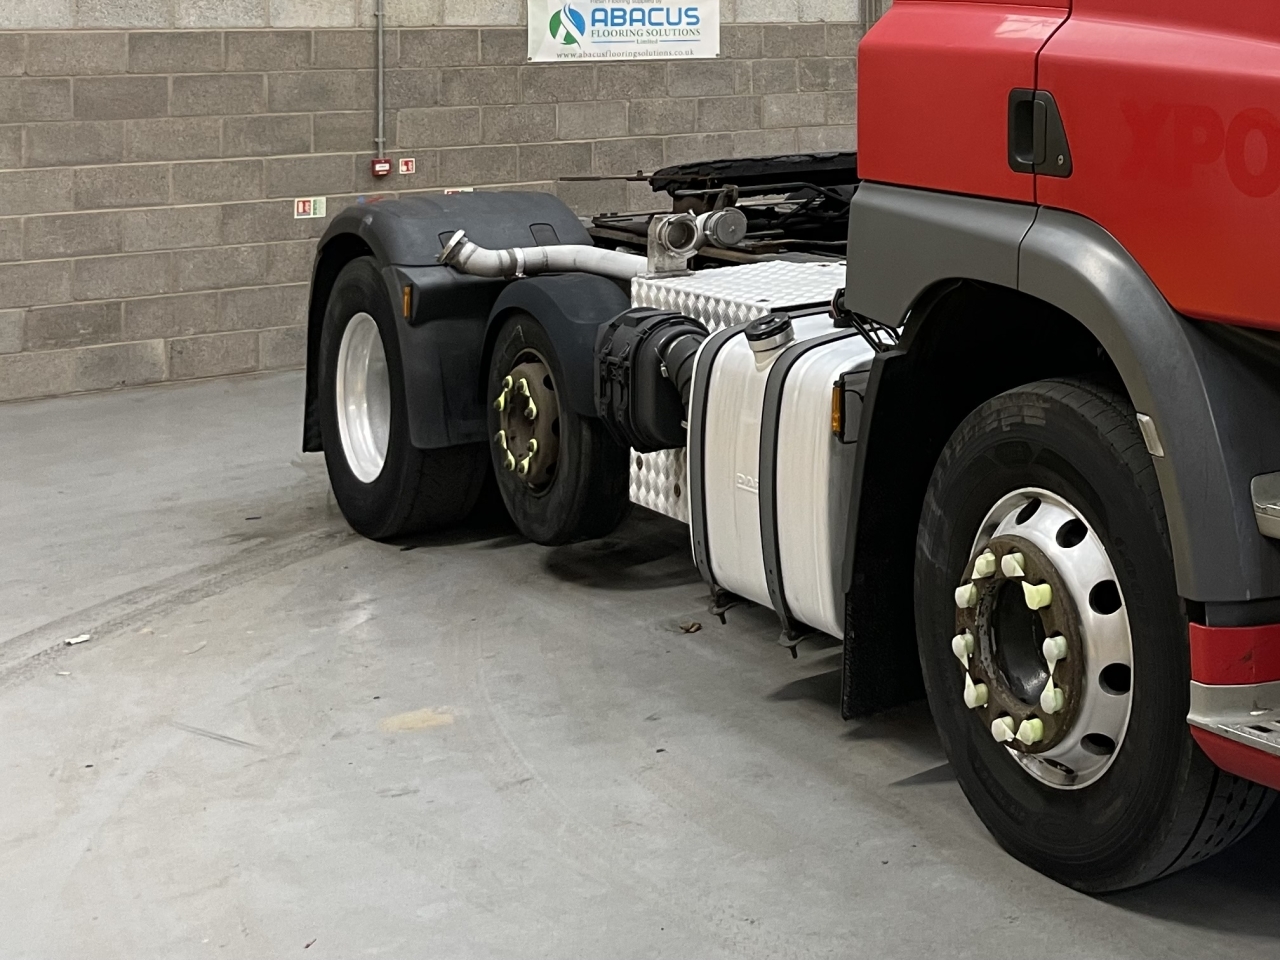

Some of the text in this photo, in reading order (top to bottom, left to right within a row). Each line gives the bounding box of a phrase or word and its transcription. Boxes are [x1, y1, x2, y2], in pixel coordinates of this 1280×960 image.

[591, 7, 701, 27] ABACUS
[591, 28, 701, 38] FLOORING SOLUTIONS
[556, 48, 695, 59] www.abacusflooringsolutions.co.uk
